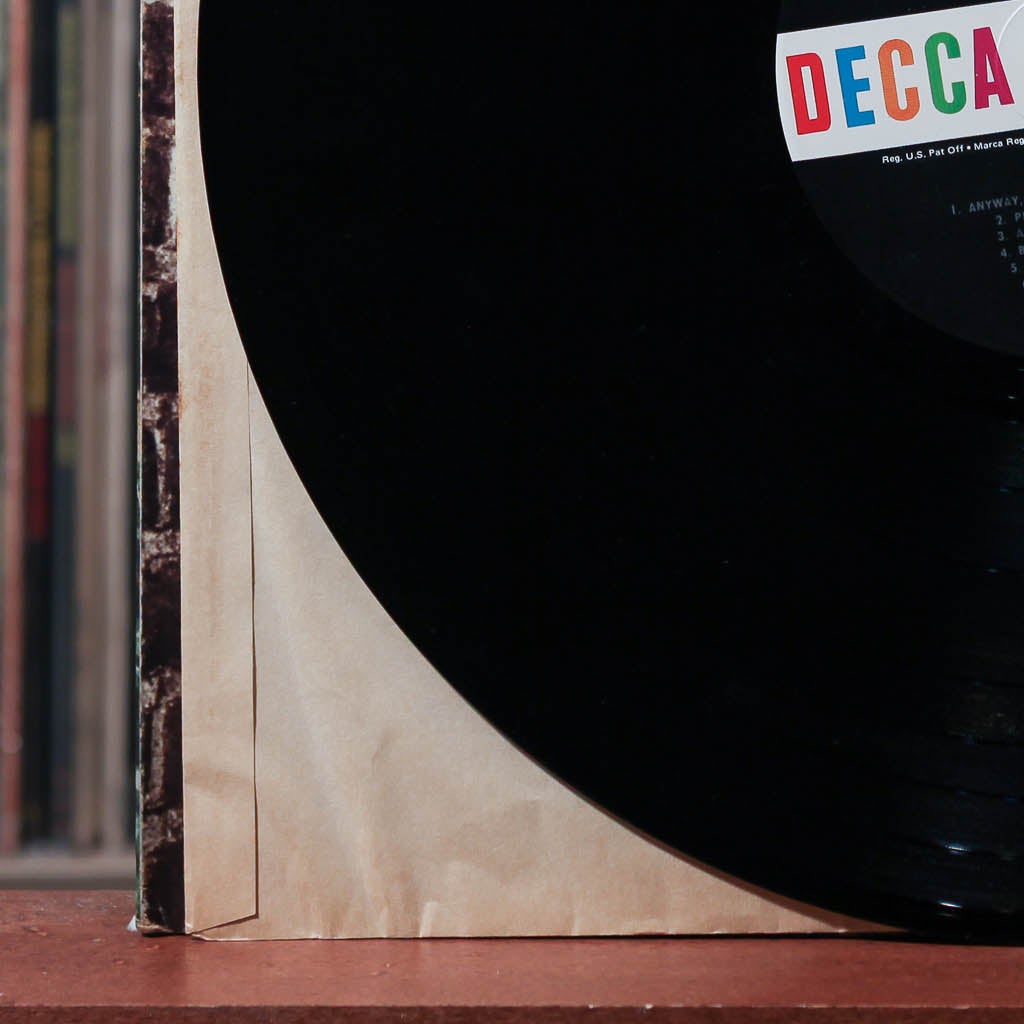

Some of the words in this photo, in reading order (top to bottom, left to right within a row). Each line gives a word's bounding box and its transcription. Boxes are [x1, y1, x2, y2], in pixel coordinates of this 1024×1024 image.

[786, 26, 1015, 135] DECCA
[882, 154, 903, 164] Reg.
[905, 149, 926, 161] U.S.
[929, 148, 945, 158] Pat
[947, 144, 964, 155] Off
[973, 140, 1003, 152] Marca
[1016, 227, 1024, 238] A
